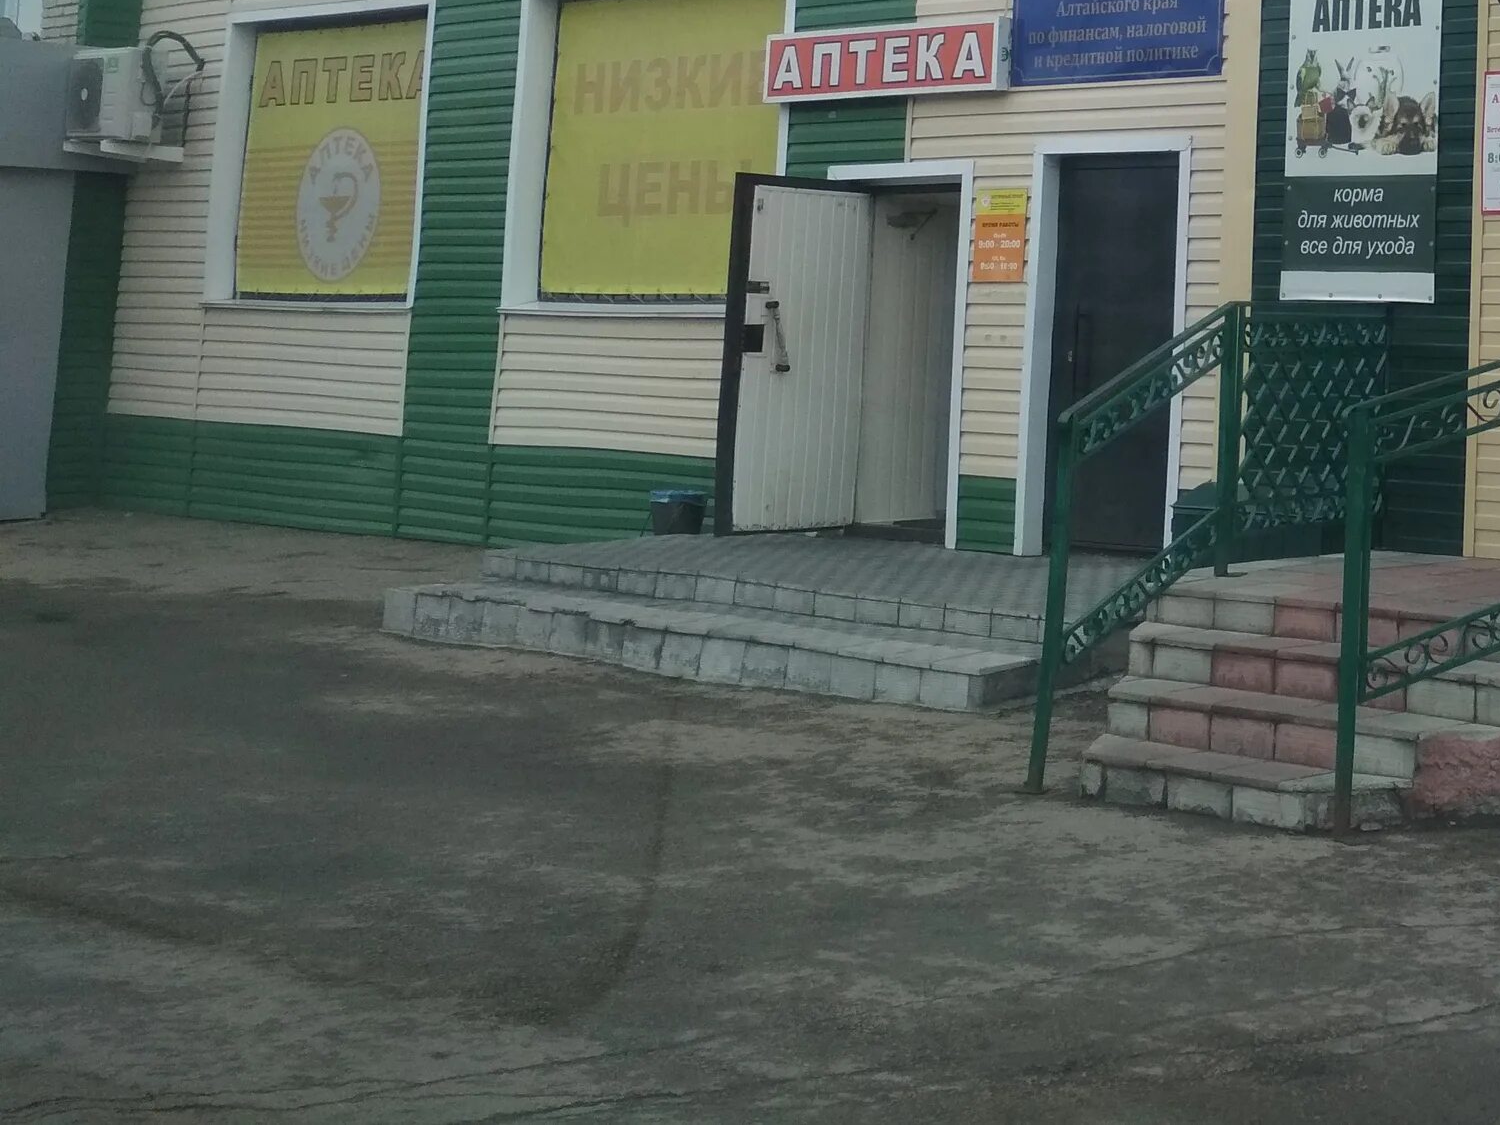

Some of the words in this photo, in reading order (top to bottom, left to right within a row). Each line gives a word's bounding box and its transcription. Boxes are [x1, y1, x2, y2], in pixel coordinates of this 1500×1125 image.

[1028, 30, 1045, 45] по
[1047, 24, 1123, 48] финансам,
[1126, 16, 1207, 39] налоговой
[773, 31, 986, 91] АПТЕКА
[1034, 55, 1043, 68] и
[1046, 47, 1123, 71] кредитной
[1126, 43, 1199, 63] политике
[258, 49, 425, 108] АПТЕКА
[1333, 186, 1384, 205] корма
[1297, 210, 1328, 230] для
[1331, 213, 1420, 229] животных
[1300, 241, 1327, 255] все
[1332, 236, 1362, 257] для
[1366, 237, 1416, 260] ухода
